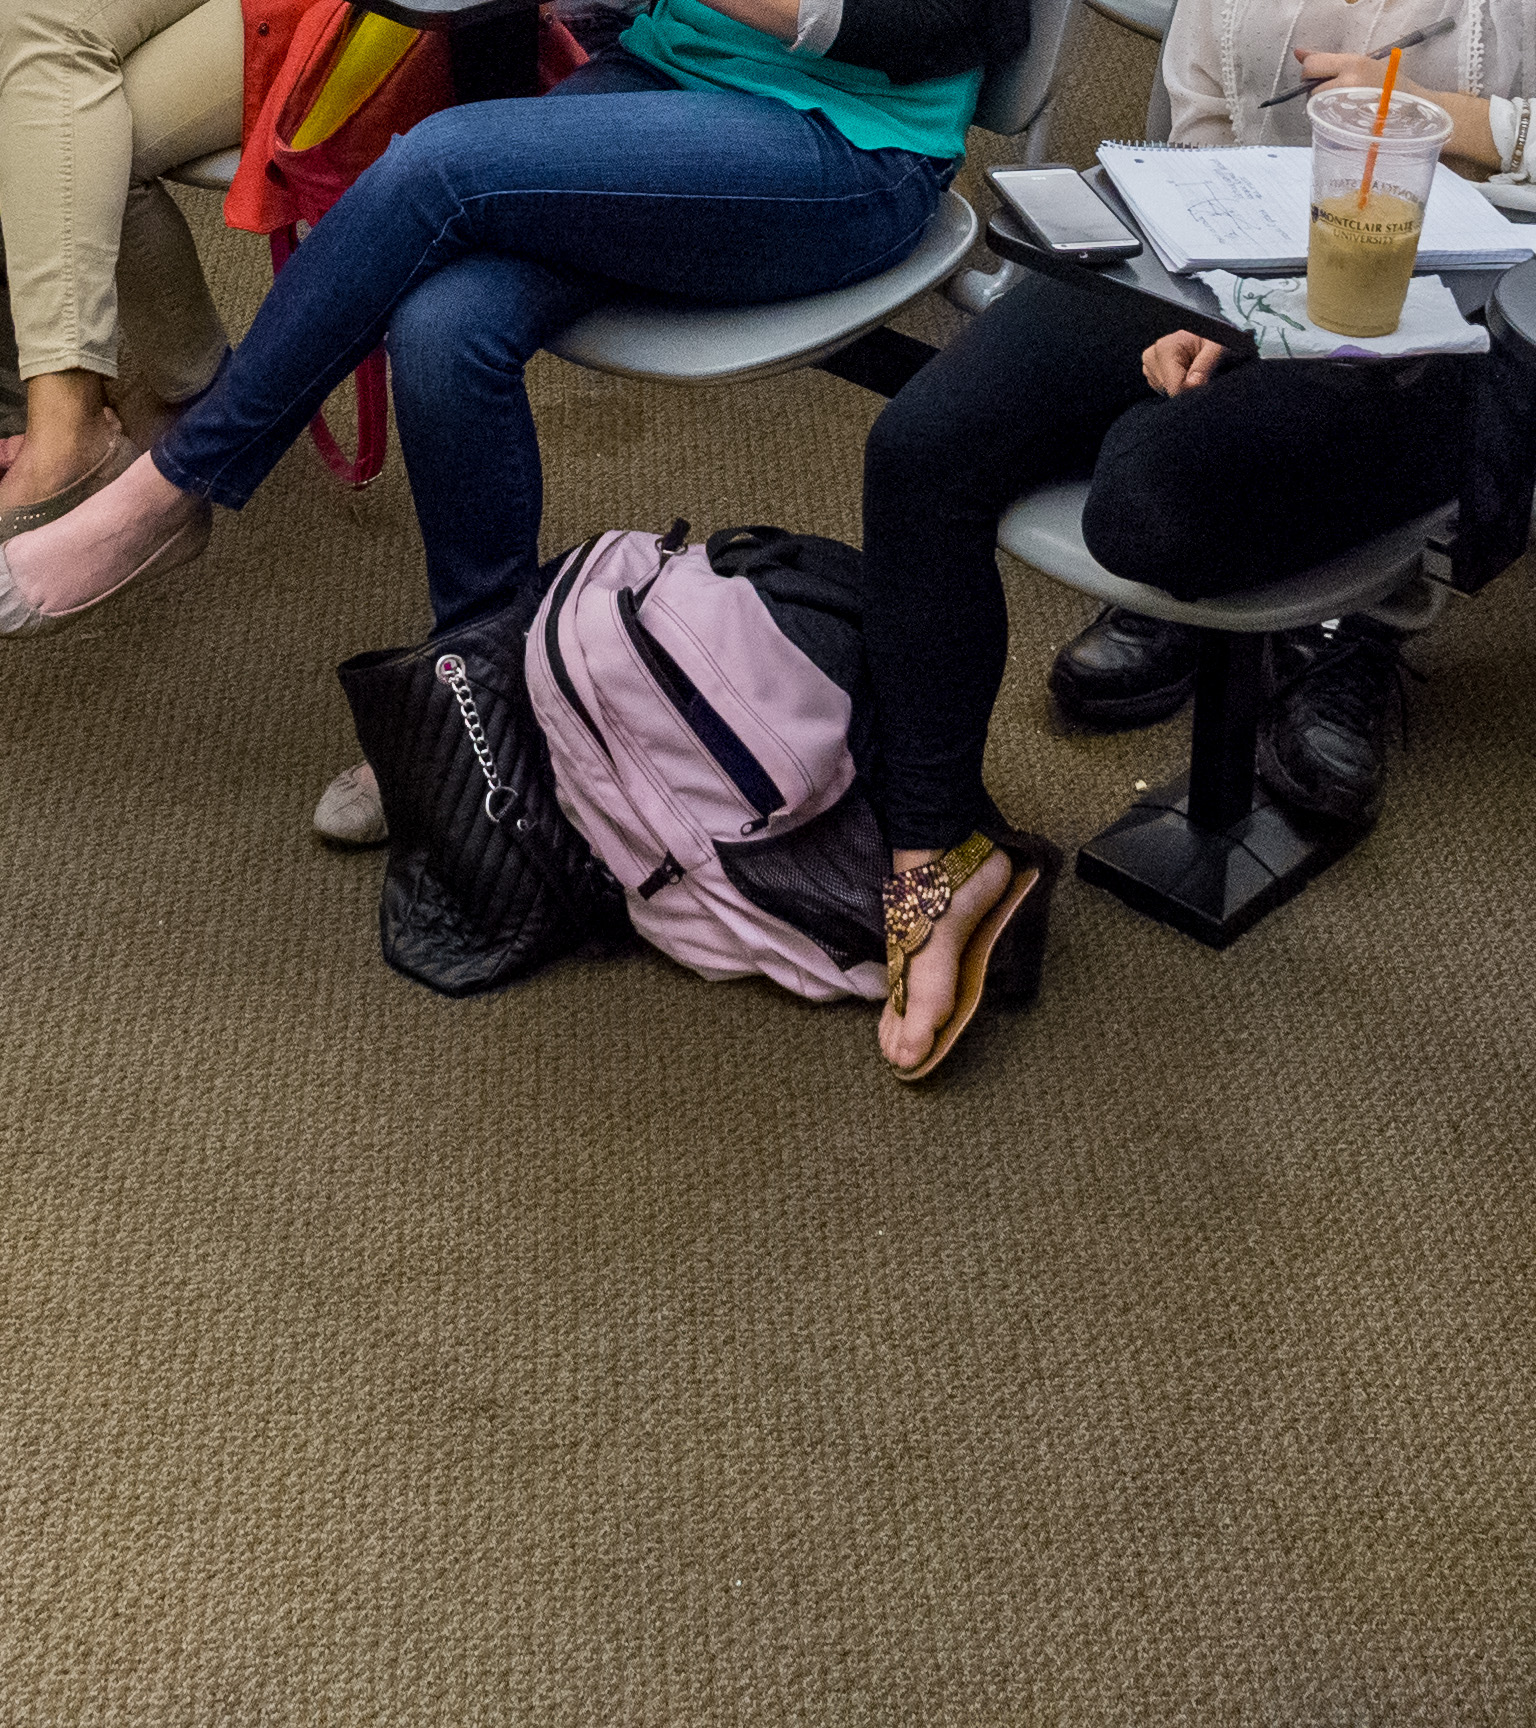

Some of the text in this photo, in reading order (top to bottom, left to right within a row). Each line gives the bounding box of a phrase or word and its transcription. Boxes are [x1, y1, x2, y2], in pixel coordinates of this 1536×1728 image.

[1319, 209, 1413, 233] MONTCLAIR STATE
[1333, 228, 1394, 245] UNIVERSITY
